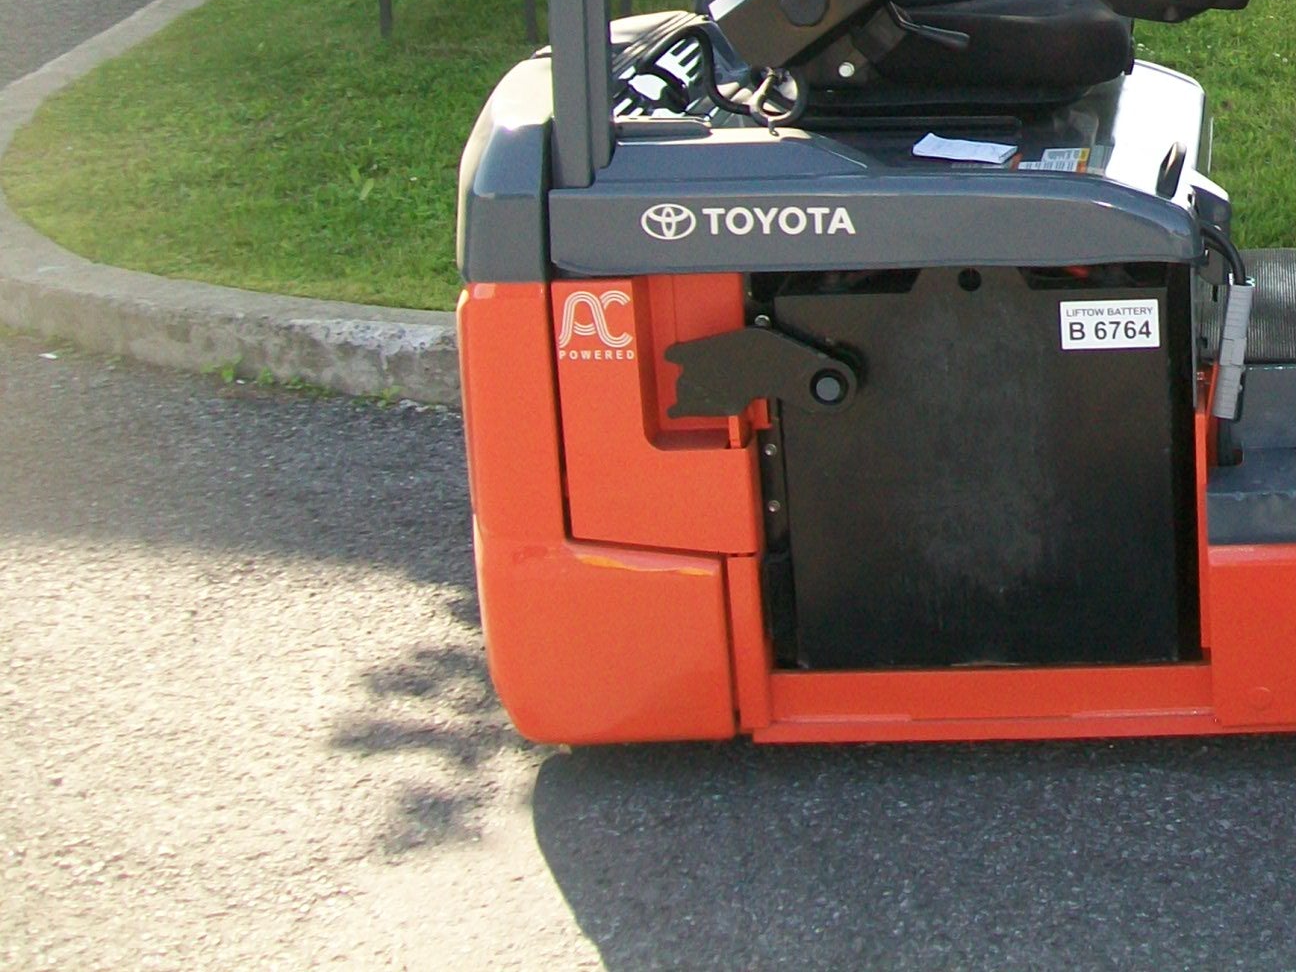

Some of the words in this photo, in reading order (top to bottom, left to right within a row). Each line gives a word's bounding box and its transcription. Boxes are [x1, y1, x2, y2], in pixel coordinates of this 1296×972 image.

[702, 207, 856, 235] TOYOTA
[1066, 308, 1104, 317] LIFTOW
[1107, 307, 1153, 316] BATTERY
[1069, 322, 1086, 340] B
[1094, 320, 1152, 340] 6764
[558, 349, 634, 360] POWERED
